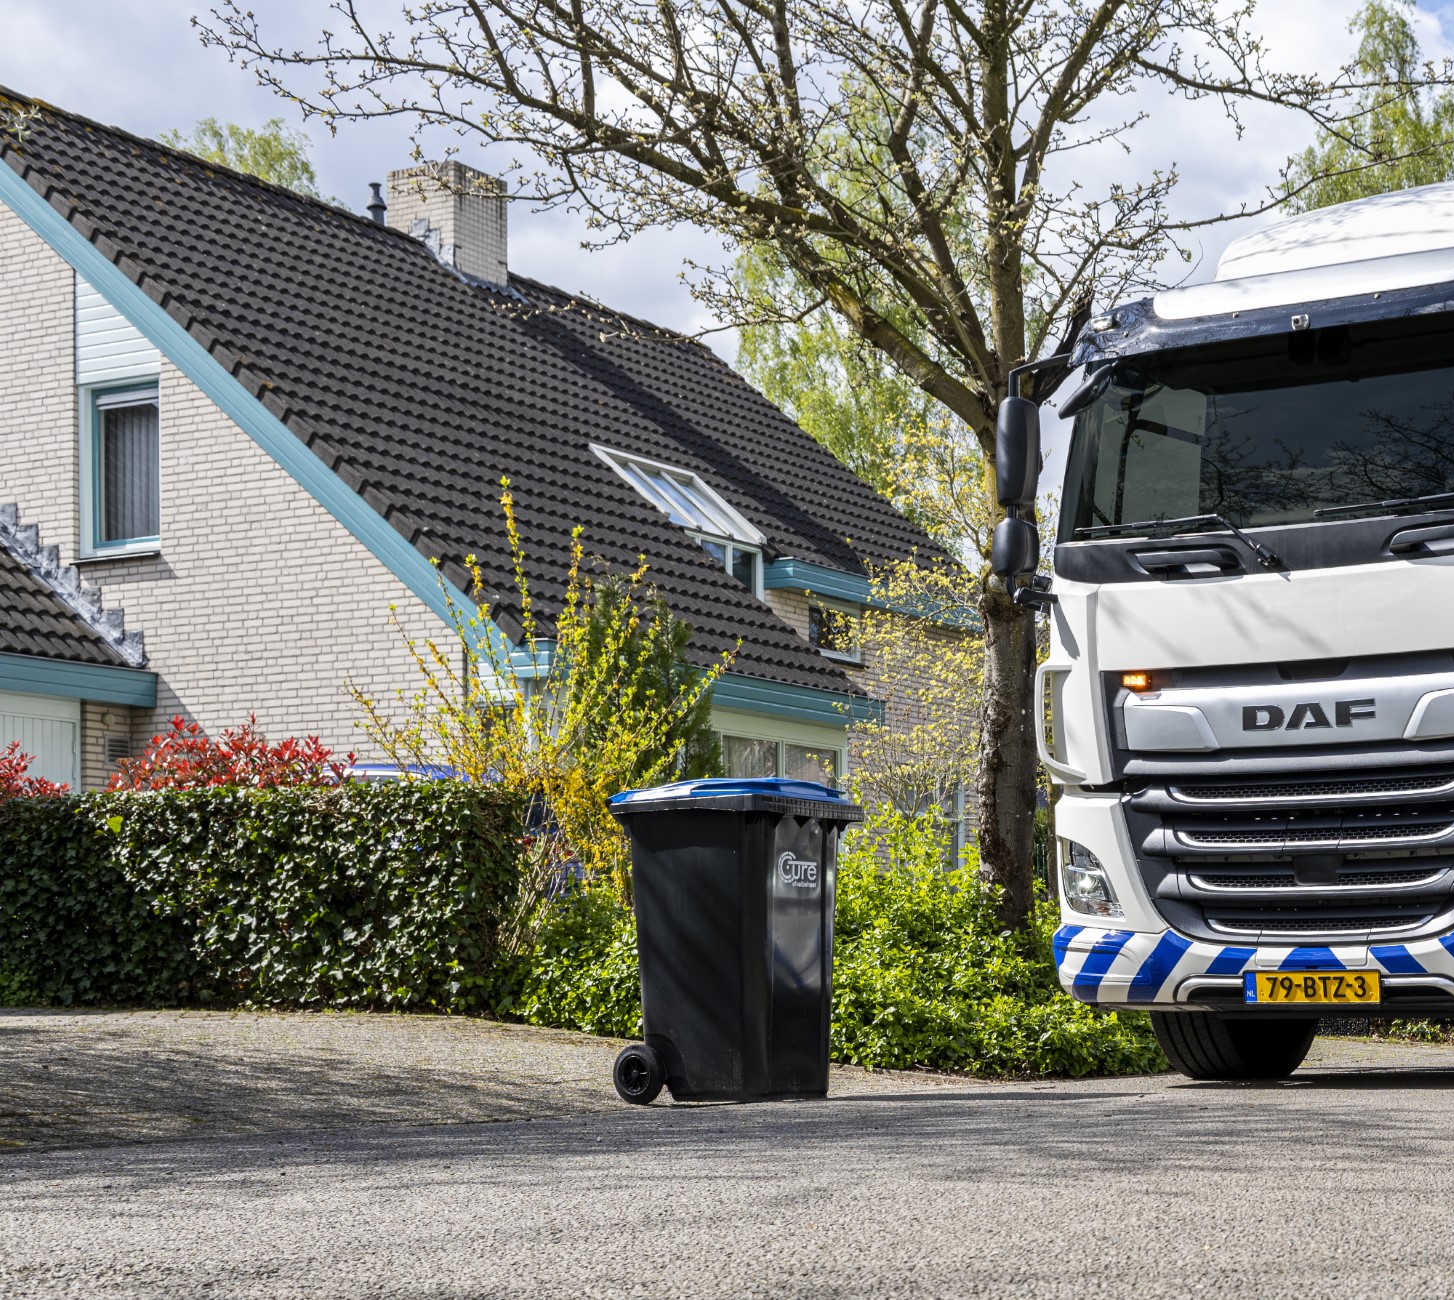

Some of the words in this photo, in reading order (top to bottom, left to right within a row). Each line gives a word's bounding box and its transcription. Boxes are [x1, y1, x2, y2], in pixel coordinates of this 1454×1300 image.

[1242, 698, 1377, 732] DAF
[780, 855, 817, 881] Cure
[1246, 990, 1256, 998] NL
[1265, 976, 1367, 998] 79-BTZ-3
